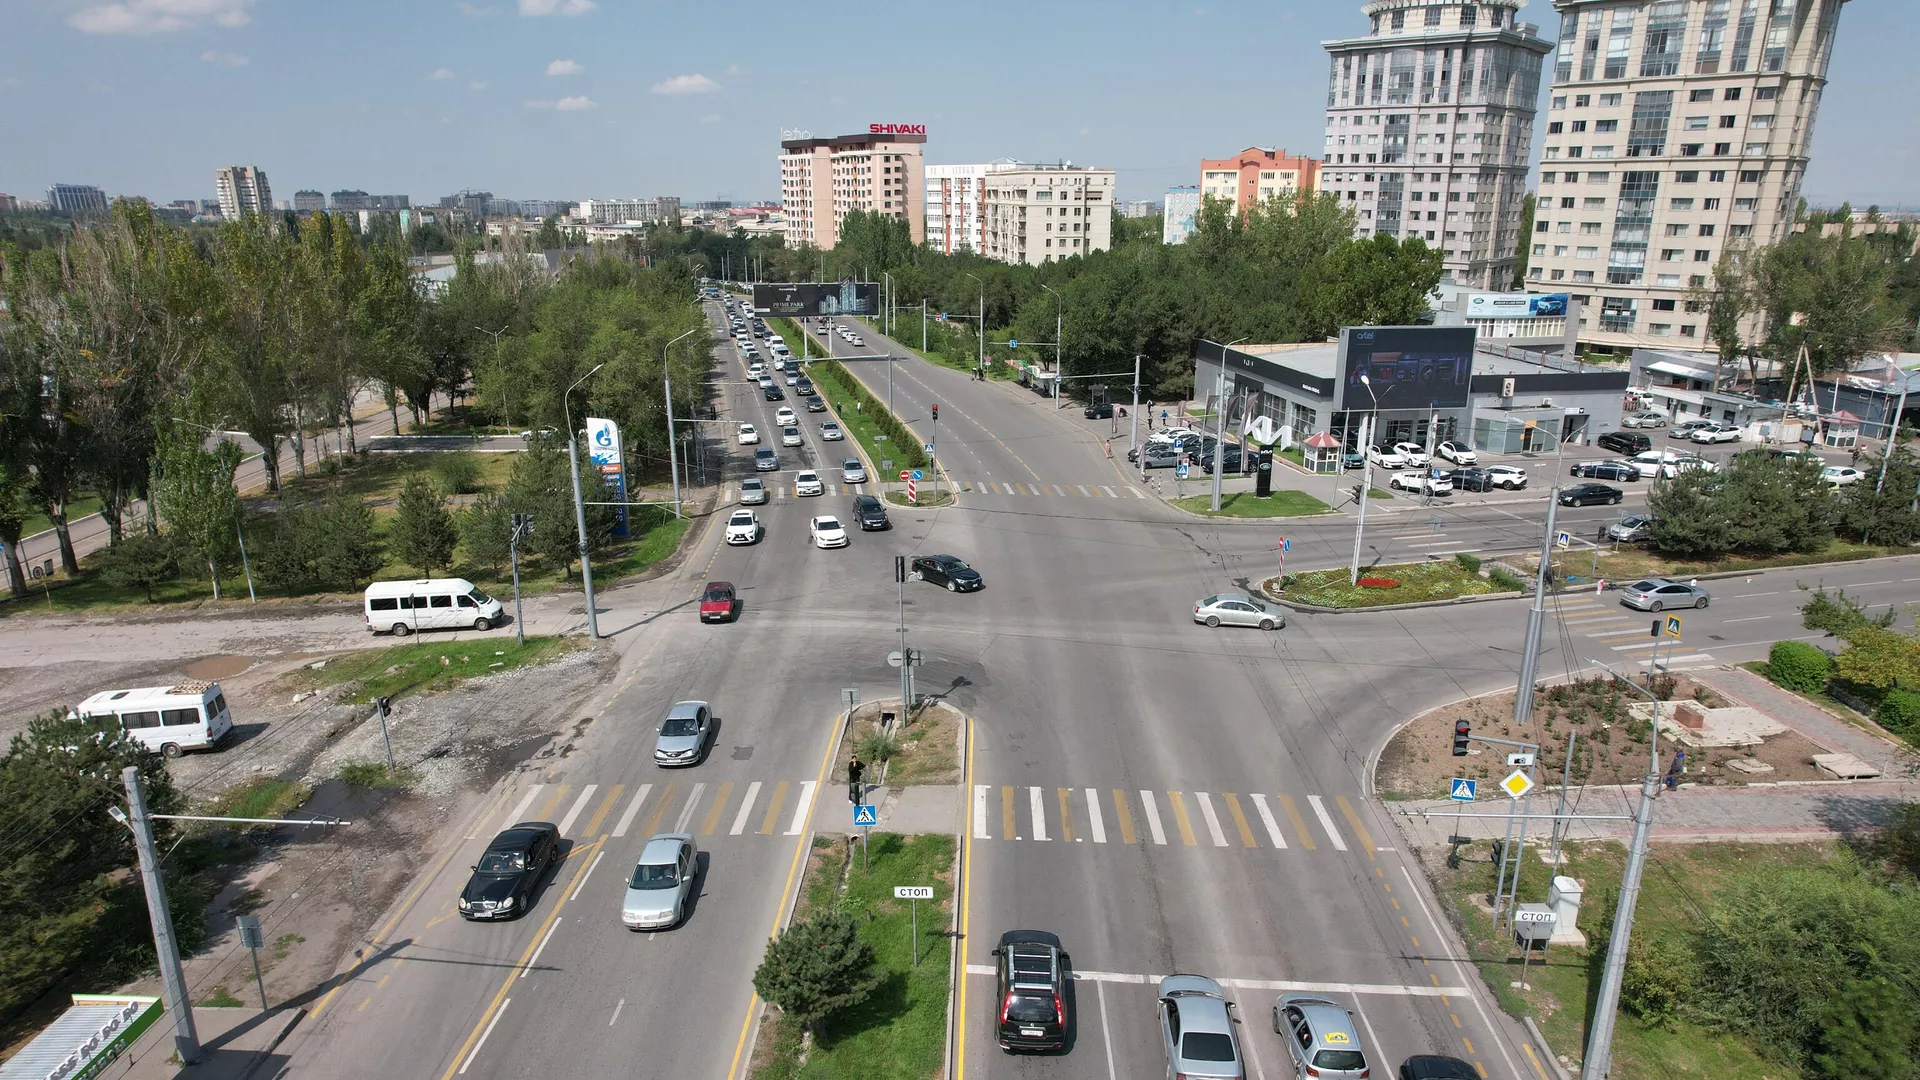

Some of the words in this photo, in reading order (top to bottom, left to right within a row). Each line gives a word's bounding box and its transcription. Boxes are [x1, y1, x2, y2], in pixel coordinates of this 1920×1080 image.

[869, 123, 926, 134] SHIVAKI
[1357, 331, 1374, 340] artel
[899, 888, 929, 897] СТОП
[1521, 912, 1552, 922] СТОП
